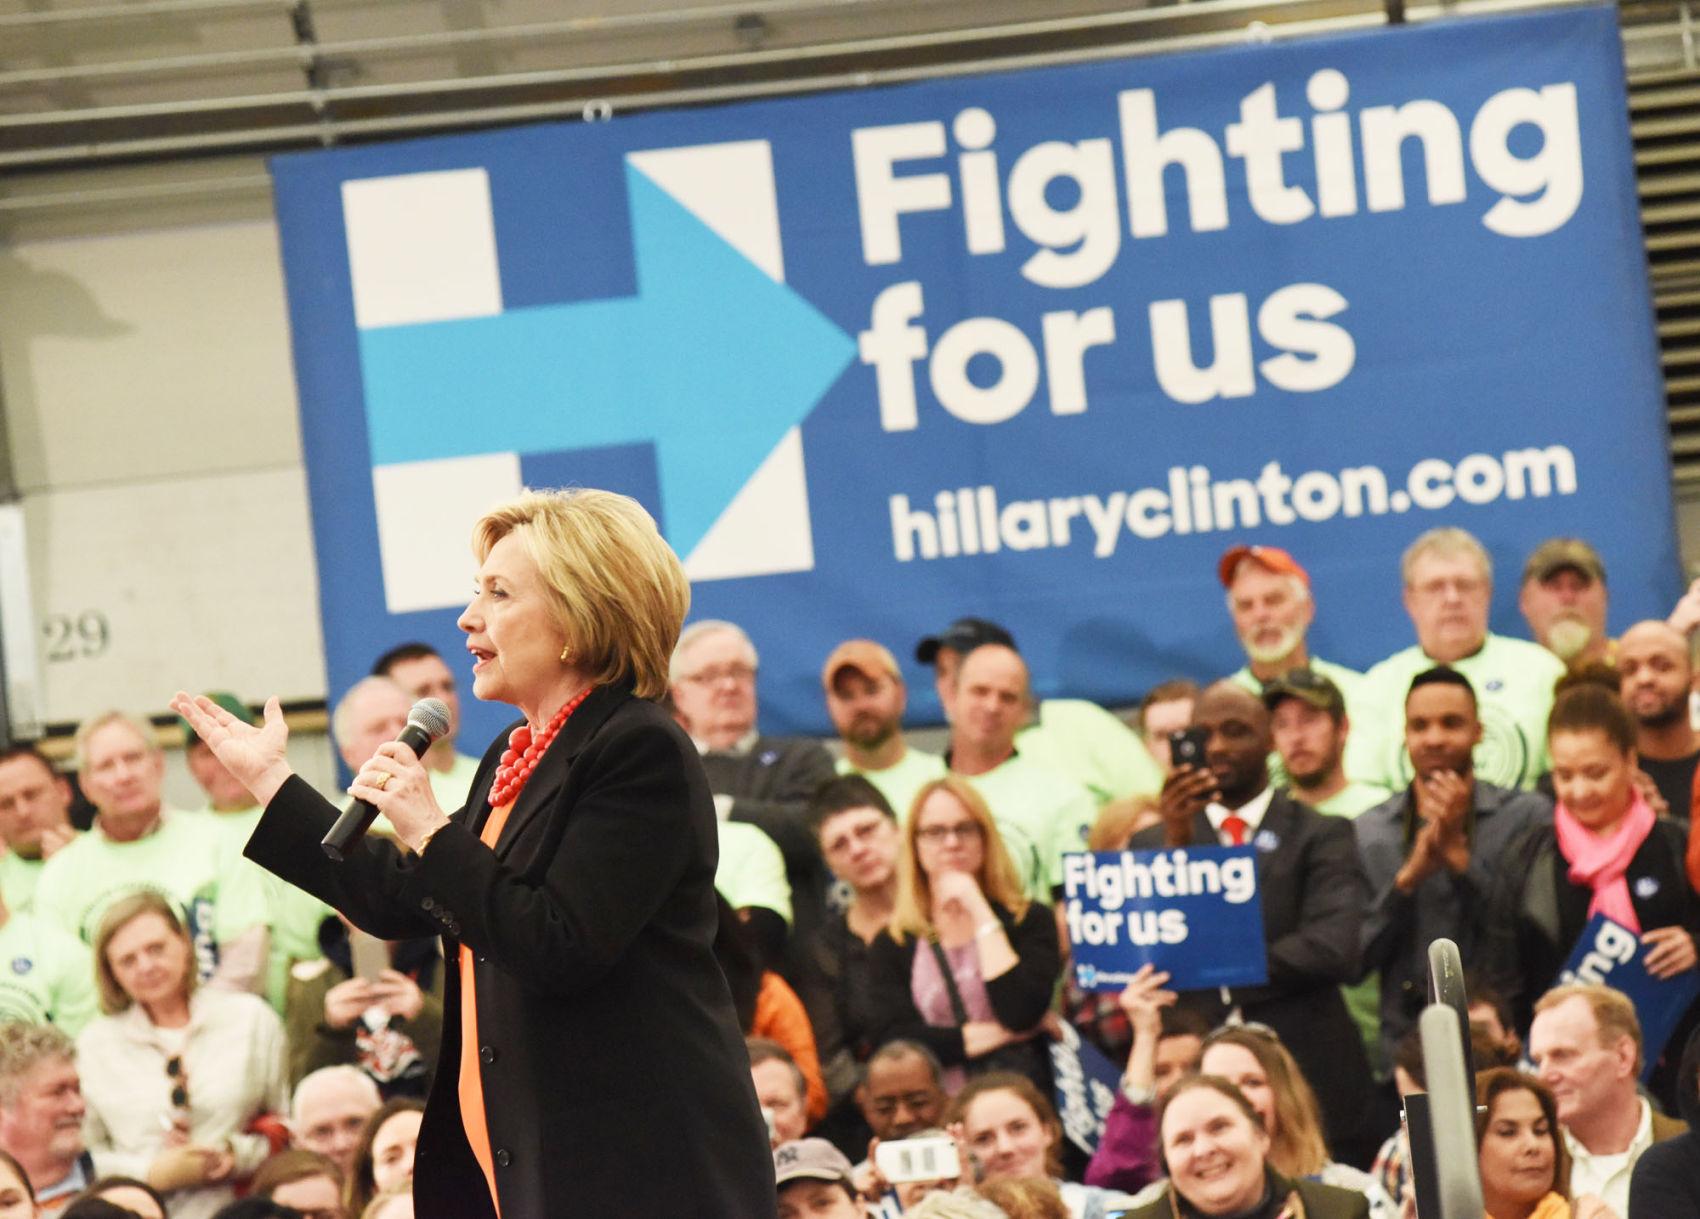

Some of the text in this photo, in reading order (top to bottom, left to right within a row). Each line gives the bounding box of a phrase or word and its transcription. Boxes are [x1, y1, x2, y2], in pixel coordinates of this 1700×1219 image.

[851, 68, 1585, 289] Fighting
[858, 281, 1357, 433] for us
[890, 445, 1577, 561] hillaryclinton.com
[43, 610, 109, 662] 29
[1064, 849, 1256, 911] Fighting
[1066, 898, 1188, 946] for us
